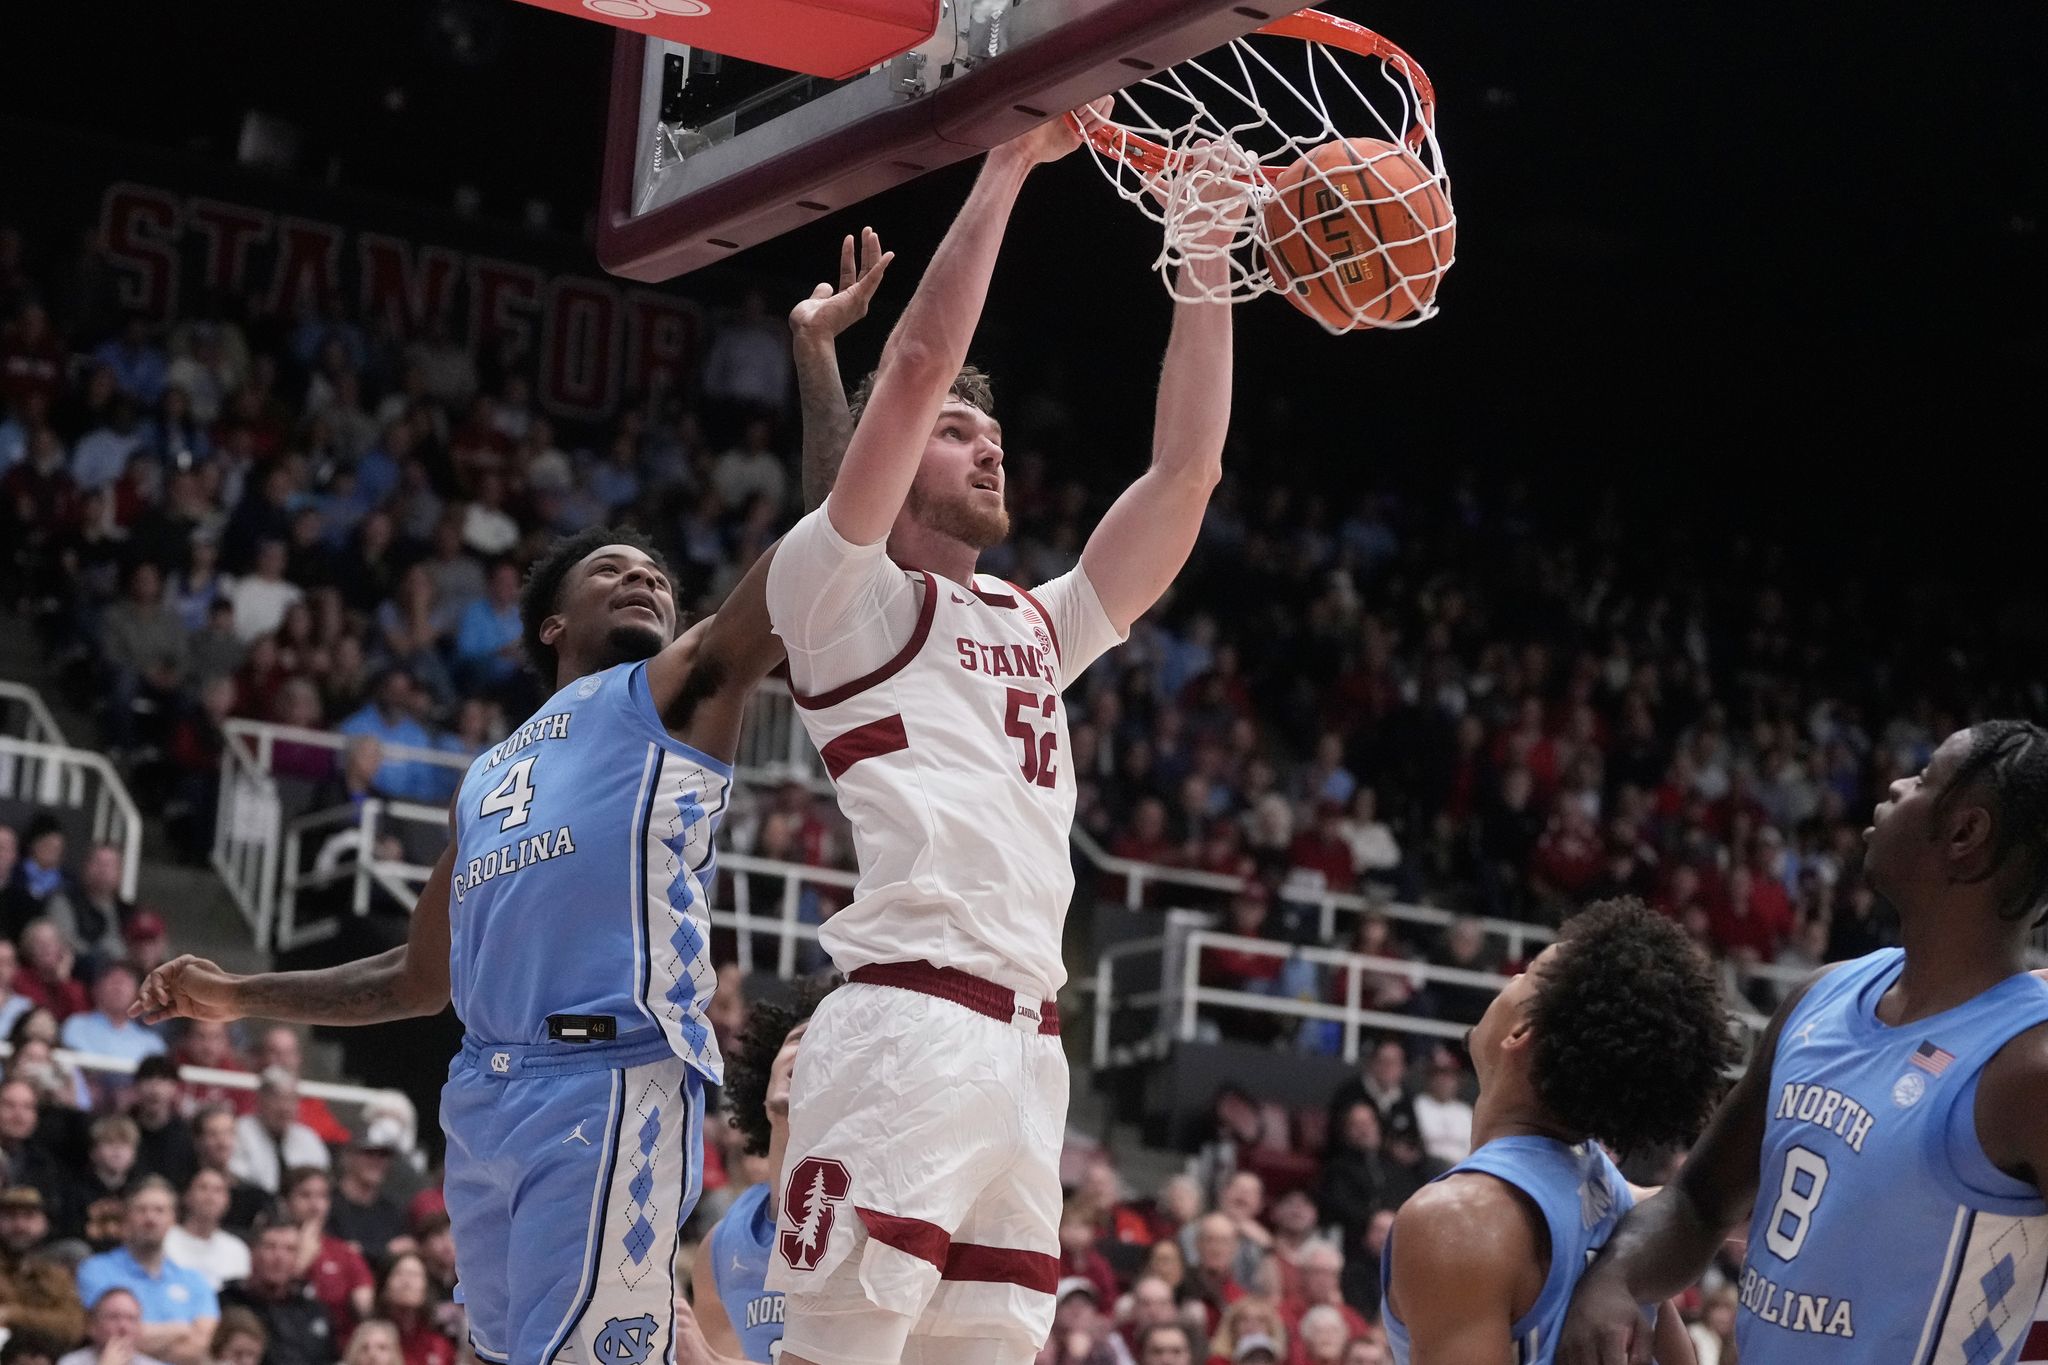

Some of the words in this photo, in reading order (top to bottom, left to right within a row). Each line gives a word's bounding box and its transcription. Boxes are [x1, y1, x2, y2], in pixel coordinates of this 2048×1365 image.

[99, 180, 712, 424] STANFOR
[482, 713, 571, 775] NORTH
[1004, 687, 1057, 788] 52
[480, 754, 539, 833] 4
[454, 826, 575, 904] CROLINA
[592, 1023, 605, 1033] 48
[1775, 1082, 1876, 1154] NORTH
[1765, 1144, 1830, 1263] 8
[745, 1295, 785, 1330] NOR
[1740, 1265, 1855, 1338] ROLINA
